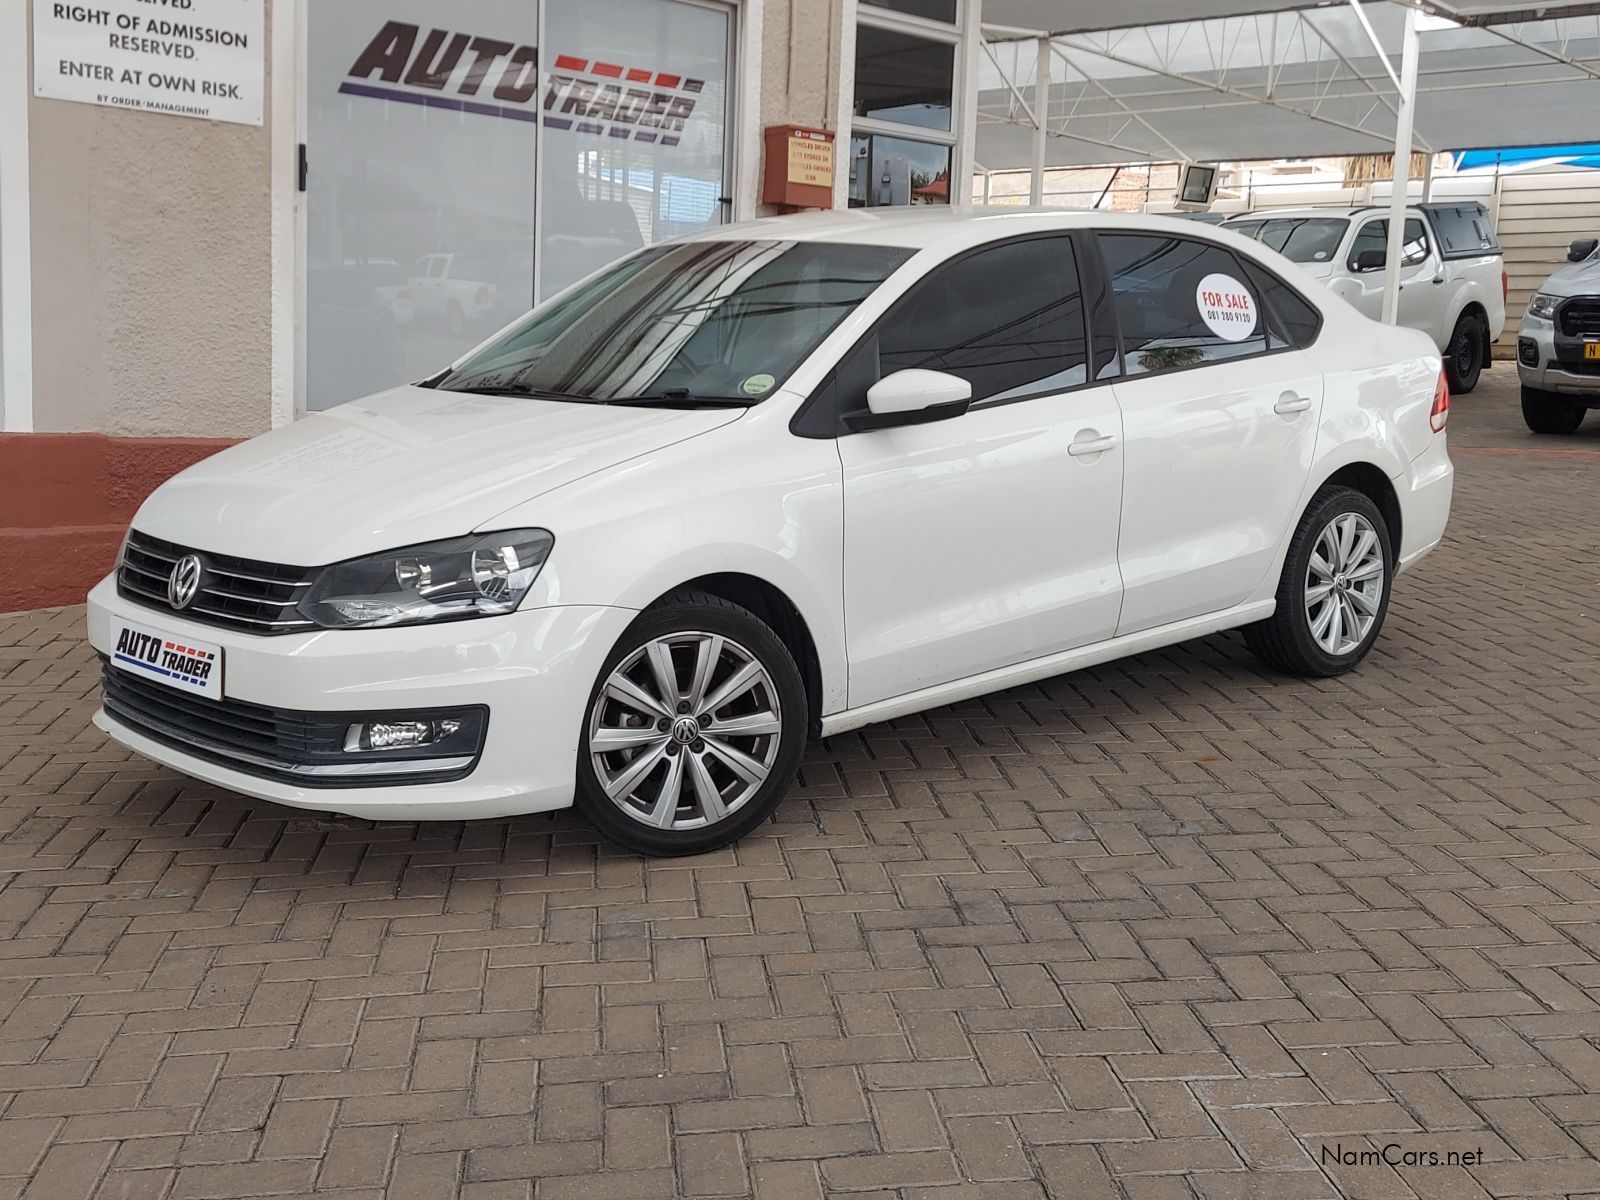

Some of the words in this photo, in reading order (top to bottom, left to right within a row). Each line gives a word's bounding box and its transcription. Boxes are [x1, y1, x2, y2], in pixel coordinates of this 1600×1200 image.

[53, 3, 110, 27] RIGHT
[116, 14, 141, 31] OF
[146, 19, 248, 49] ADMISSION
[109, 33, 199, 61] RESERVED.
[59, 59, 114, 82] ENTER
[120, 69, 143, 86] AT
[148, 73, 196, 93] OWN
[202, 81, 243, 101] RISK.
[347, 20, 539, 104] AUTO
[542, 73, 697, 132] TRADER
[97, 94, 109, 103] BY
[111, 96, 141, 107] ORDER
[146, 100, 210, 116] MANAGEMENT
[1202, 291, 1223, 307] FOR
[1225, 293, 1249, 309] SALE
[1207, 310, 1219, 320] 081
[1221, 311, 1233, 321] 280
[1235, 312, 1250, 323] 9120
[116, 628, 162, 663] AUTO
[161, 651, 212, 679] TRADER
